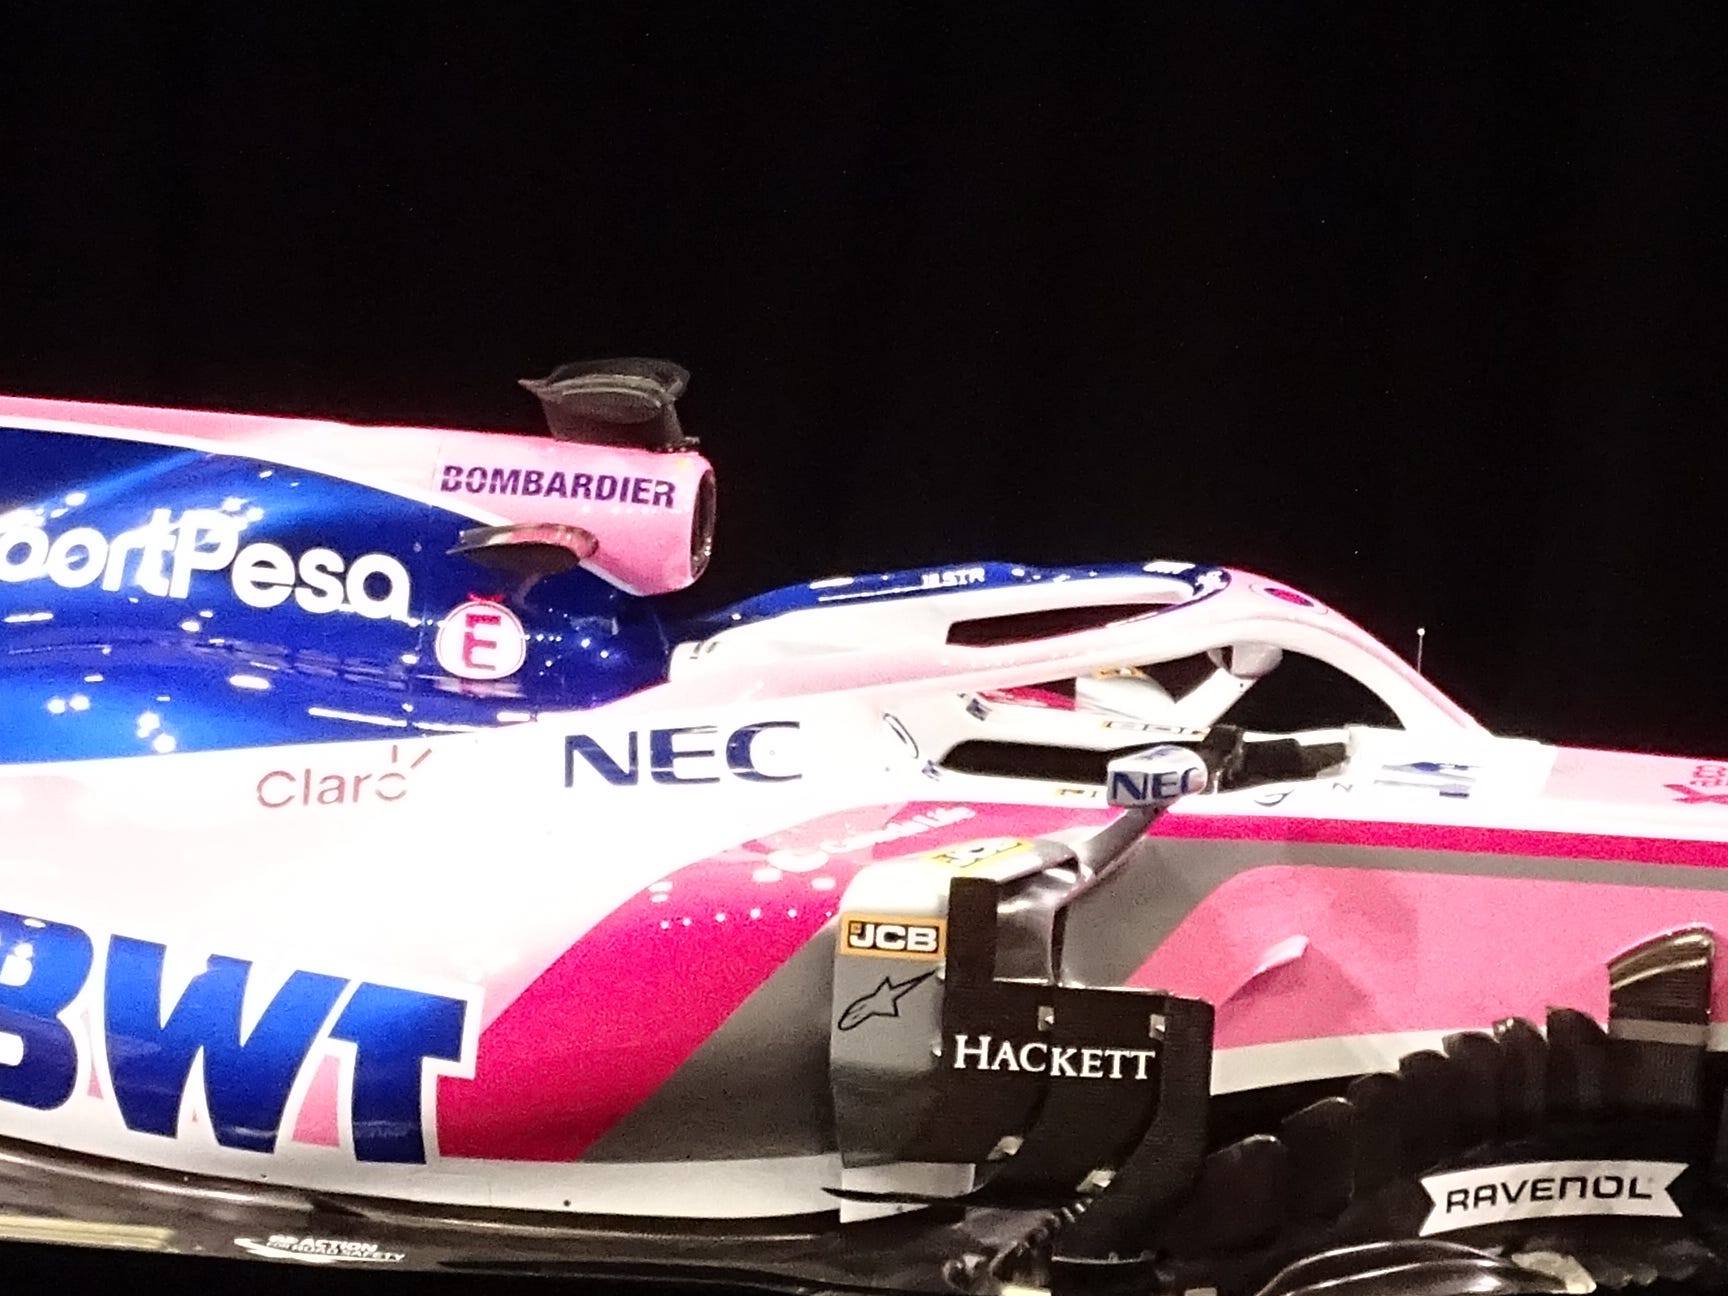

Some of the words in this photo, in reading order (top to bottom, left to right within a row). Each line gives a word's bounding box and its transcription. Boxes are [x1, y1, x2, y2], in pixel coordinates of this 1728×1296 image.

[440, 464, 677, 509] BOMBARDIER
[563, 720, 802, 788] NEC
[257, 769, 407, 809] Claro
[1111, 766, 1200, 802] NEC
[848, 922, 939, 953] JCB
[953, 1034, 1157, 1082] HACKETT
[1444, 1174, 1656, 1215] RAVENOL
